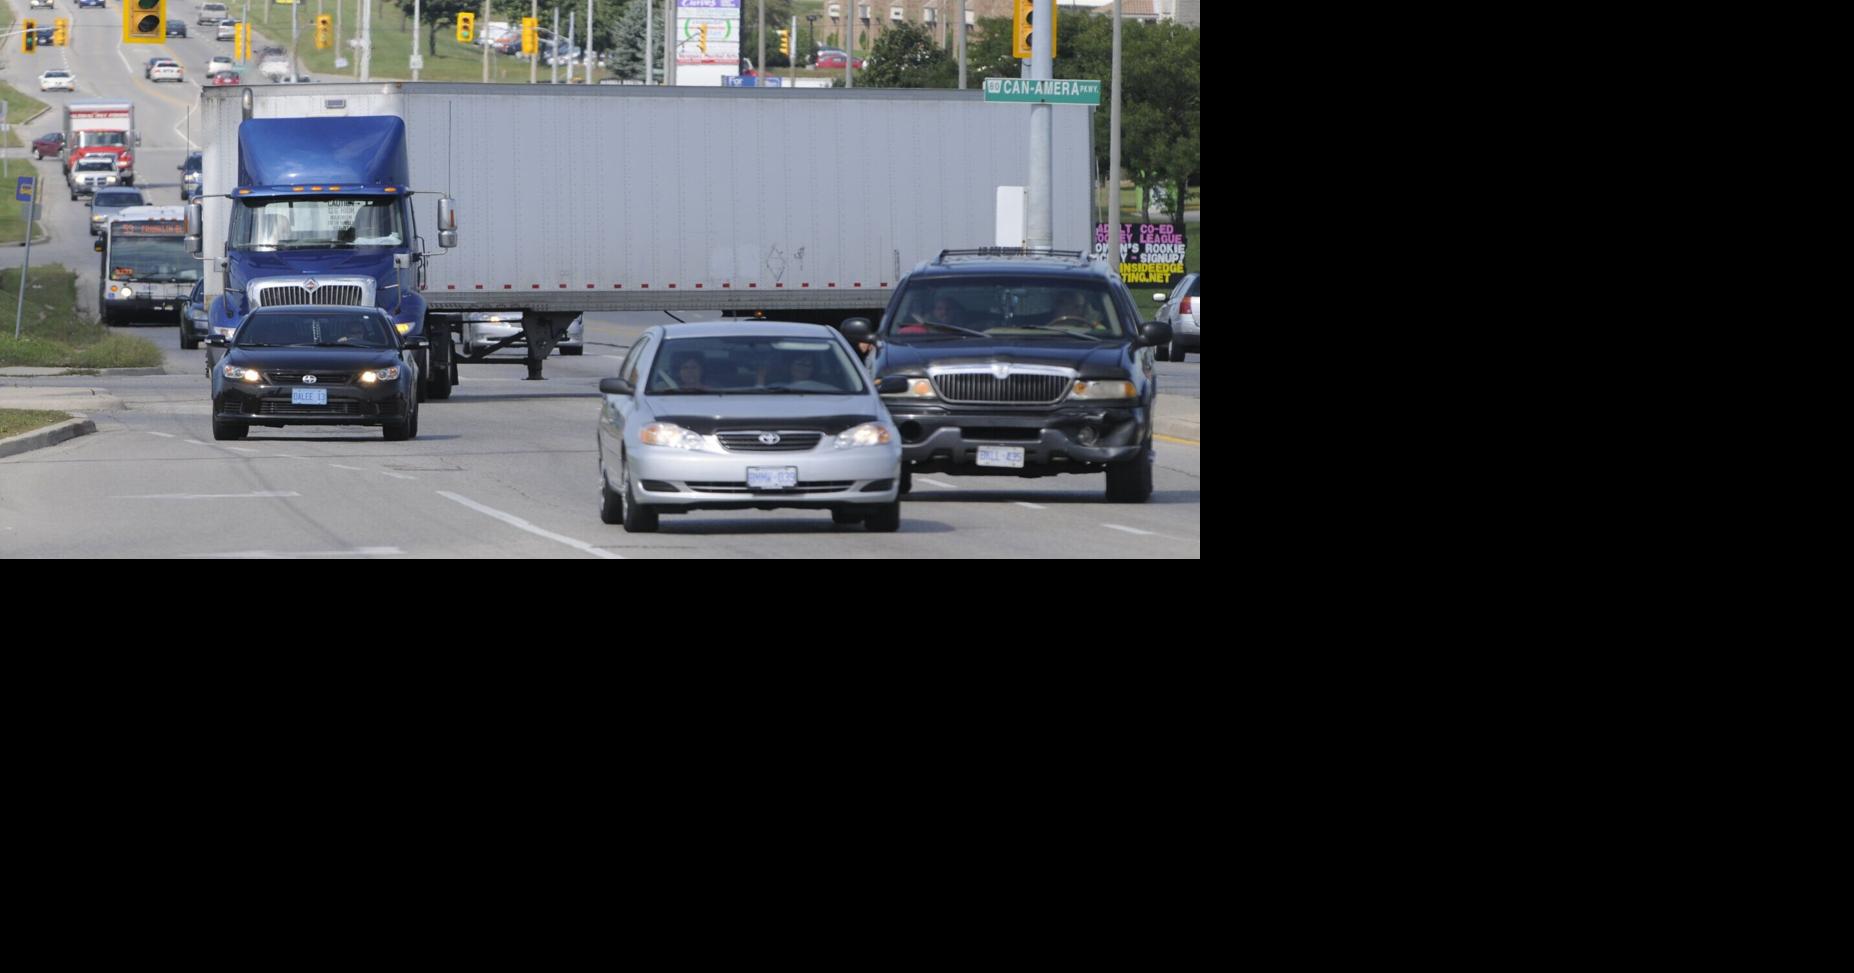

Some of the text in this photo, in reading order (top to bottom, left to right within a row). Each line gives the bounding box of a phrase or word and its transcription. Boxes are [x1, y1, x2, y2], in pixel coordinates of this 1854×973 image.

[1003, 80, 1080, 95] CAN-AMERA
[1097, 224, 1173, 234] ADLT CO-ED
[1140, 234, 1182, 243] LEAGUE
[1145, 243, 1185, 254] ROOKIE
[1119, 263, 1184, 273] INSIDEEDGE
[1121, 272, 1170, 283] TING.NET
